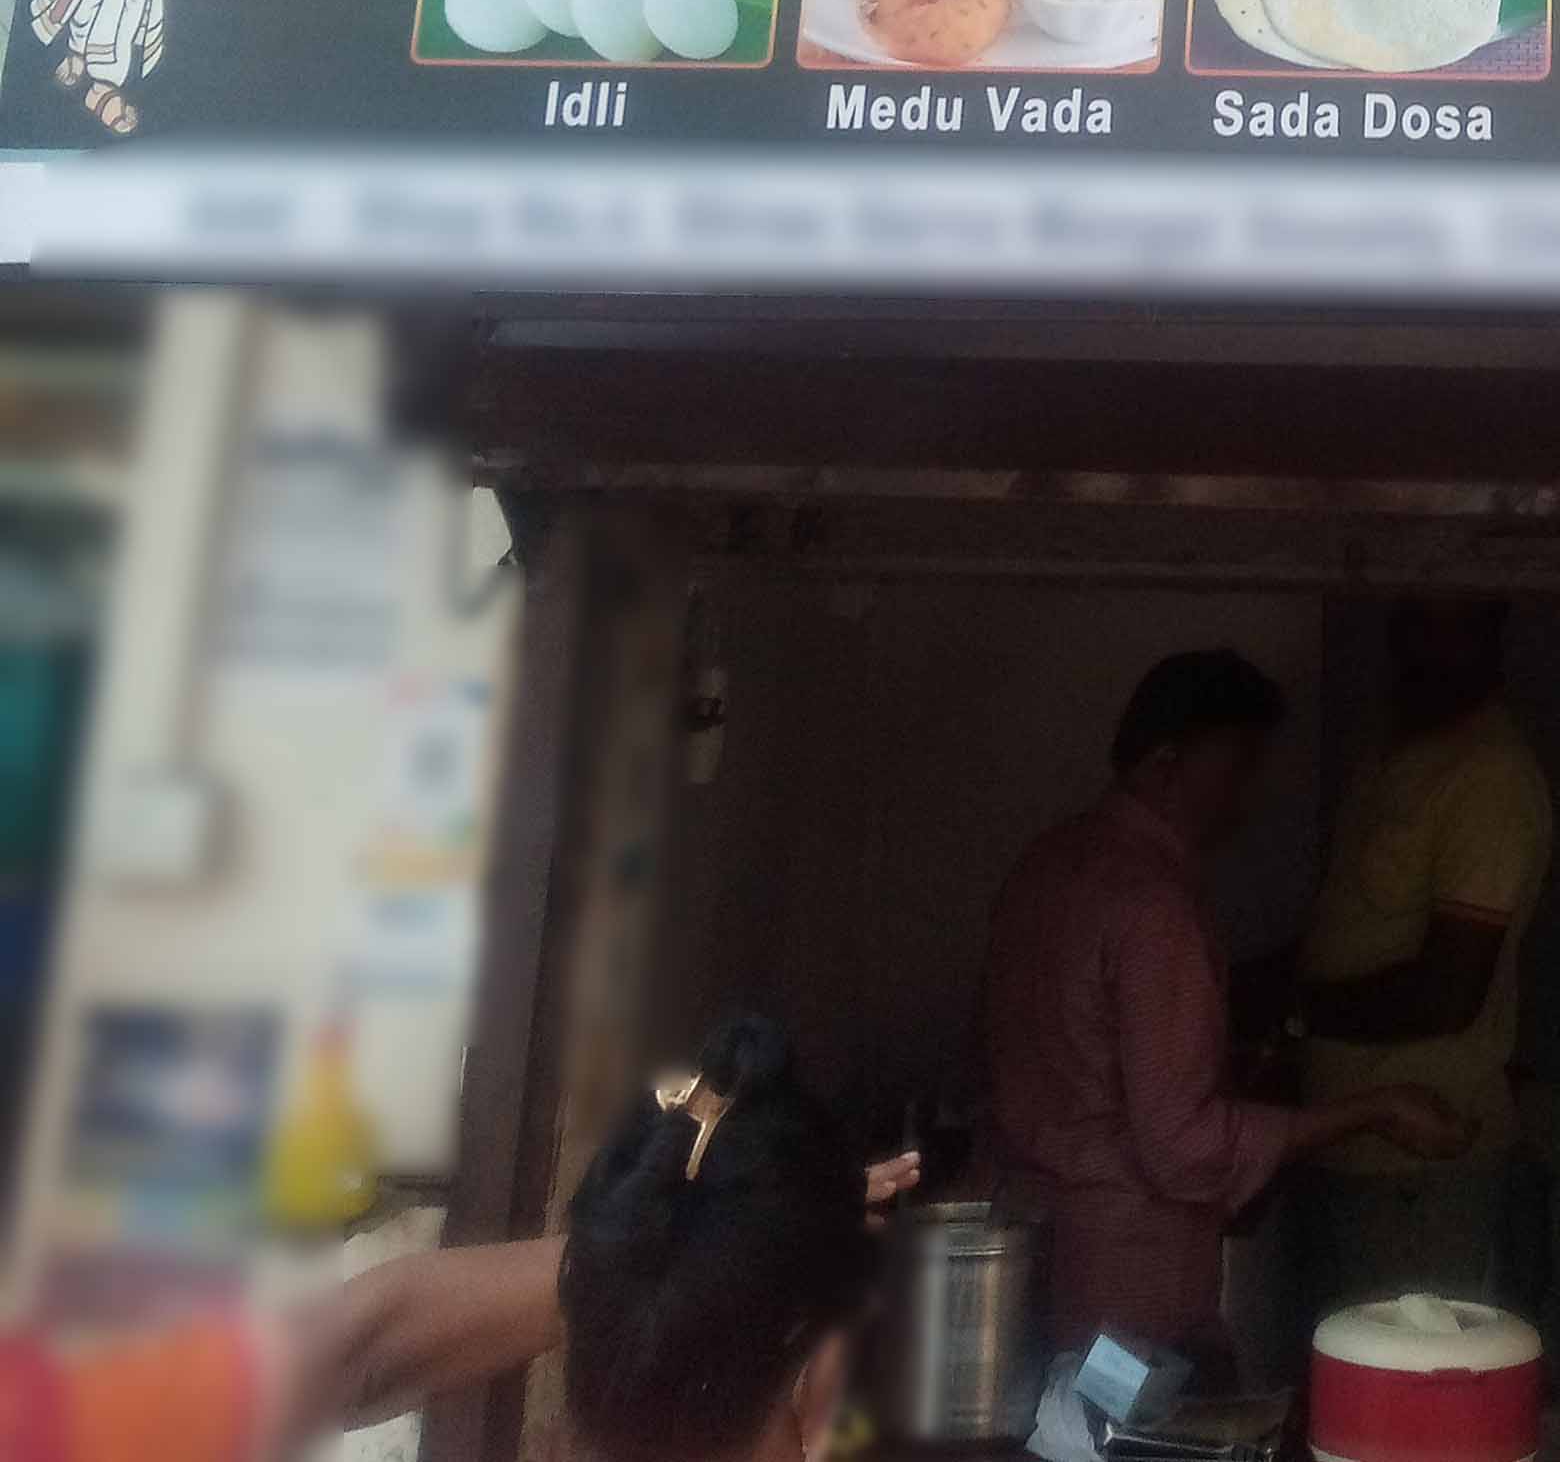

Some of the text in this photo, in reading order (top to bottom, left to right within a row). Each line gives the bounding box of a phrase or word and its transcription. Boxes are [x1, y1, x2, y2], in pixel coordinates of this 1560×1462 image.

[544, 81, 628, 127] Idli
[826, 84, 1112, 134] Medu Vada
[1213, 89, 1492, 141] Sada Dosa
